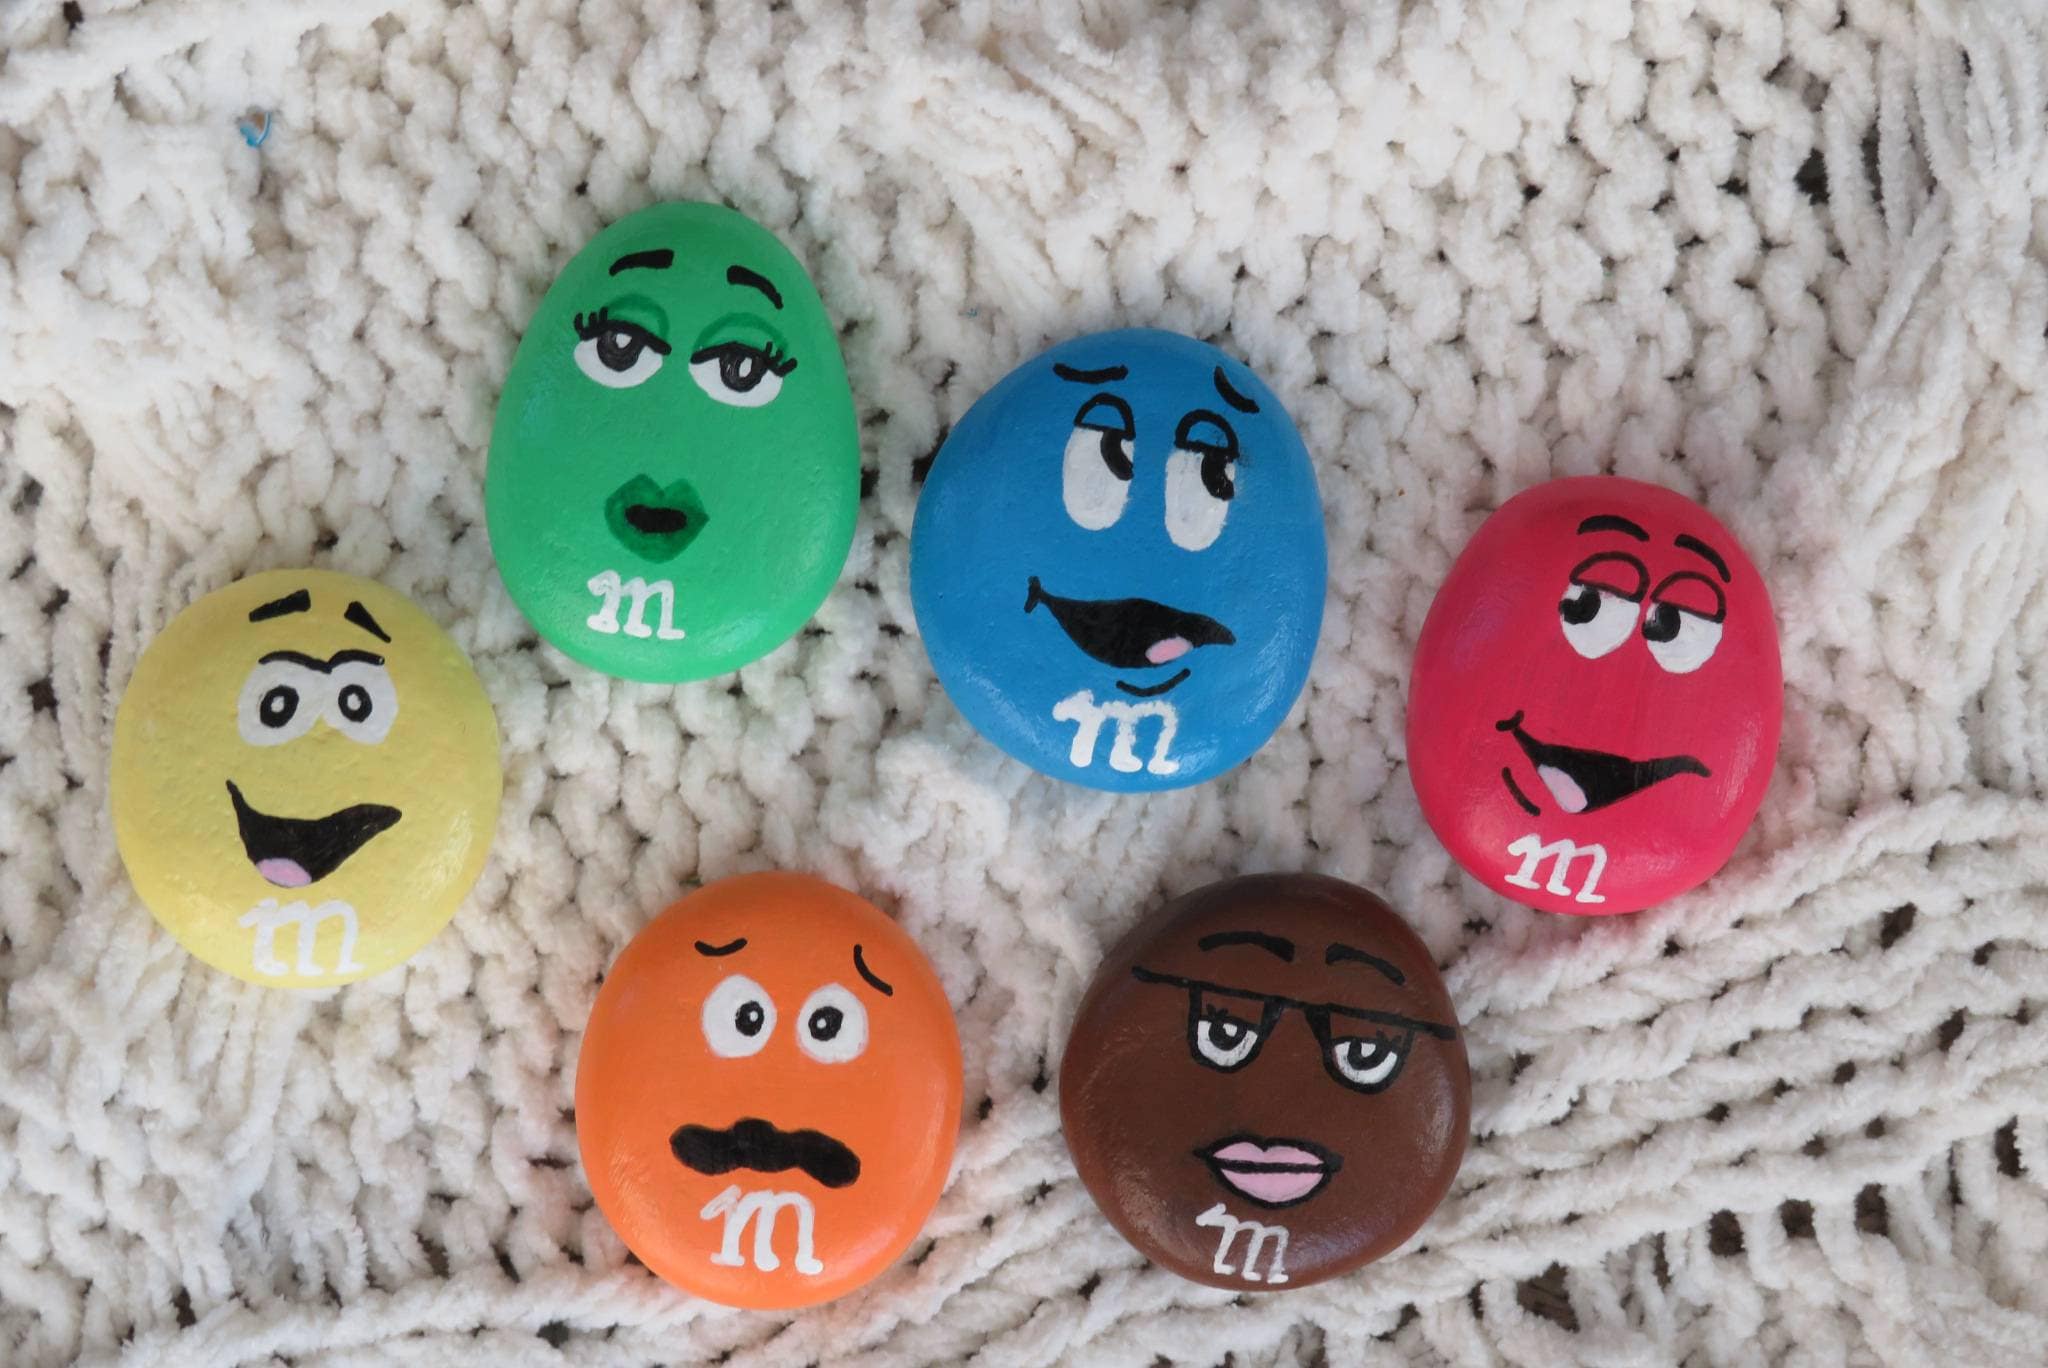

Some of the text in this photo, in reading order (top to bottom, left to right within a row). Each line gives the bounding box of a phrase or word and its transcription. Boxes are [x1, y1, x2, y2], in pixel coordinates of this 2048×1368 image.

[586, 569, 685, 641] m
[1053, 689, 1180, 775] m
[1505, 833, 1607, 904] m
[239, 896, 366, 979] m
[699, 1184, 825, 1276] m
[1196, 1203, 1288, 1285] m
